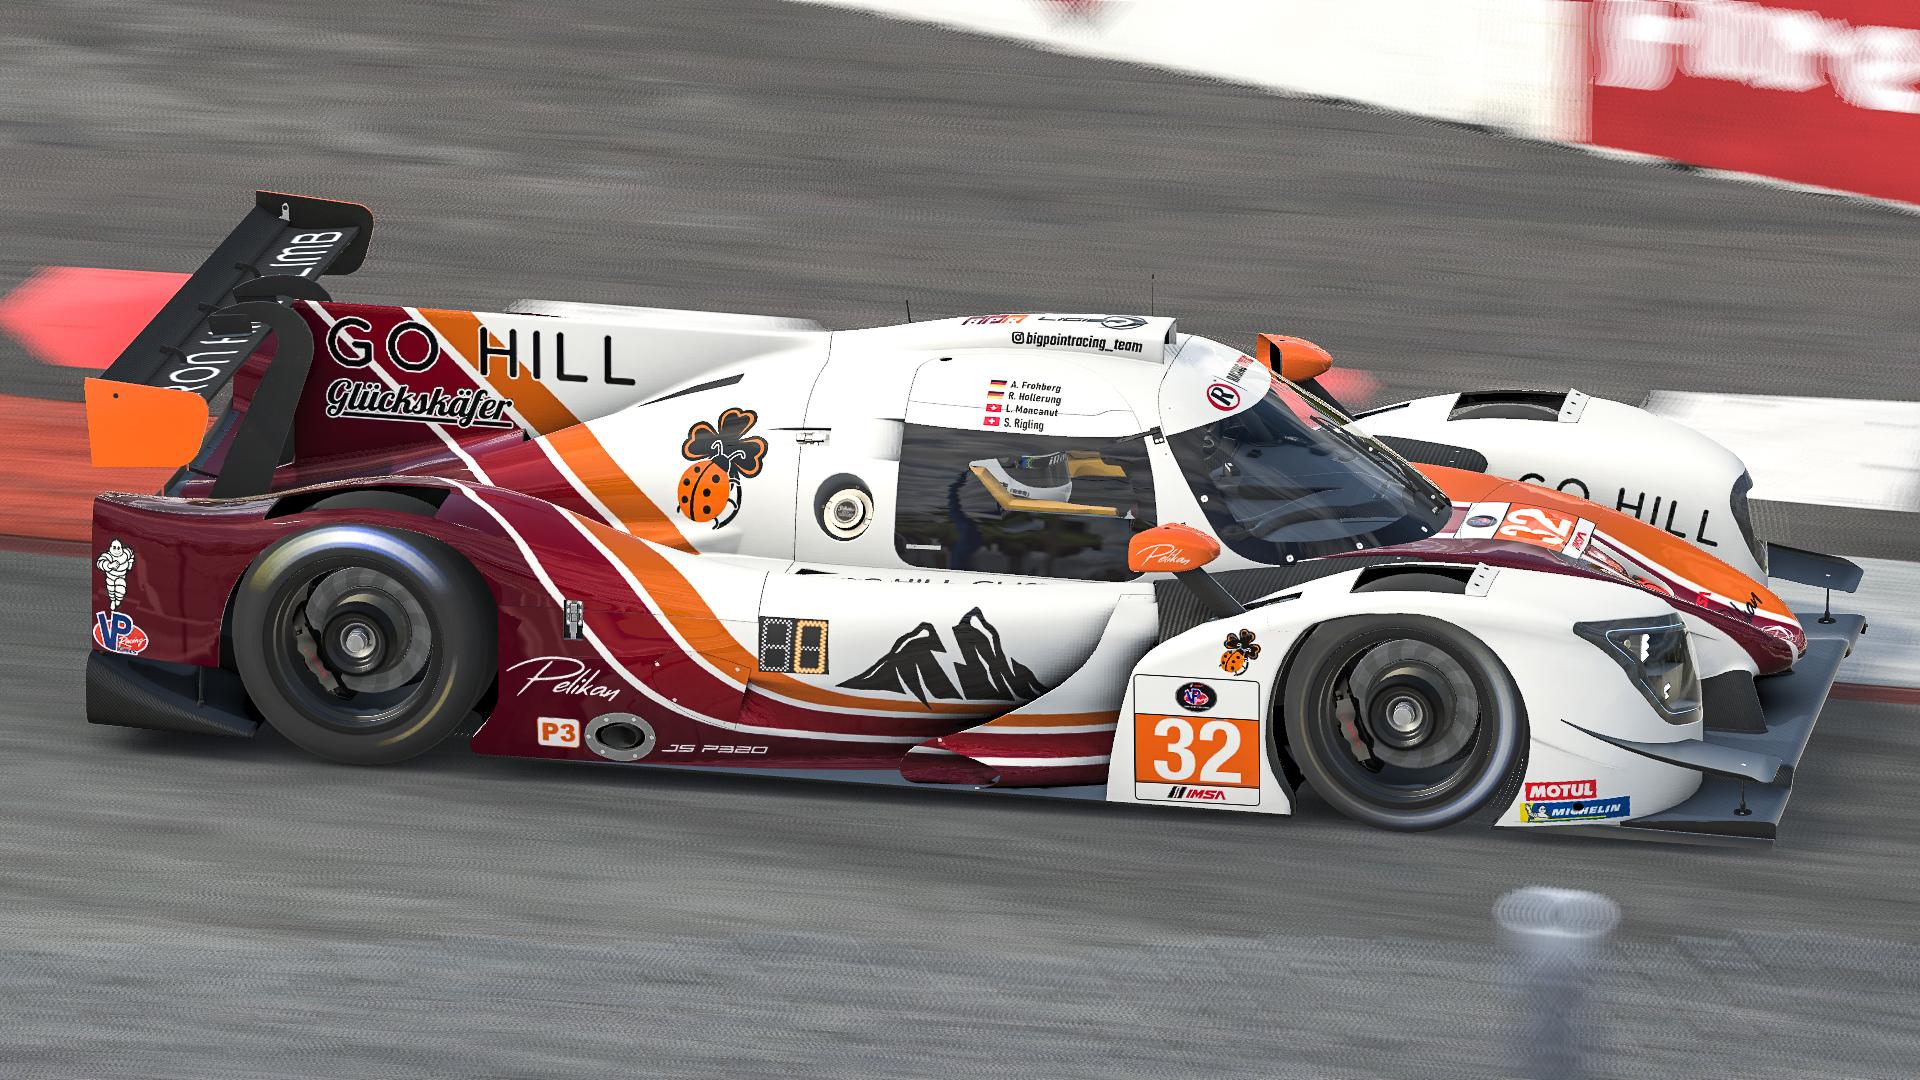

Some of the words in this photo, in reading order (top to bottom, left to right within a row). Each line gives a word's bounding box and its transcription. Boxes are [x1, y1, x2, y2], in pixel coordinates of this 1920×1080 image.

[326, 316, 440, 372] GO
[478, 325, 636, 386] HILL
[1026, 332, 1143, 353] bigpointracing_team
[1010, 380, 1019, 389] A.
[1021, 381, 1062, 393] Frohberg
[325, 378, 513, 427] Glückskäfer
[1008, 391, 1016, 400] R.
[1019, 392, 1062, 406] Hollerung
[1005, 404, 1013, 413] L.
[1015, 405, 1059, 417] Moncanut
[1003, 417, 1012, 428] S.
[1014, 418, 1044, 432] Rigling
[1616, 487, 1719, 548] HILL
[96, 611, 133, 652] VP
[506, 656, 620, 702] Pelikan
[541, 722, 576, 743] P3
[701, 744, 769, 755] P320
[1153, 717, 1242, 784] 32
[1186, 789, 1227, 801] IMSA
[1529, 784, 1594, 799] MOTUL
[1551, 804, 1621, 816] MICHELIN
